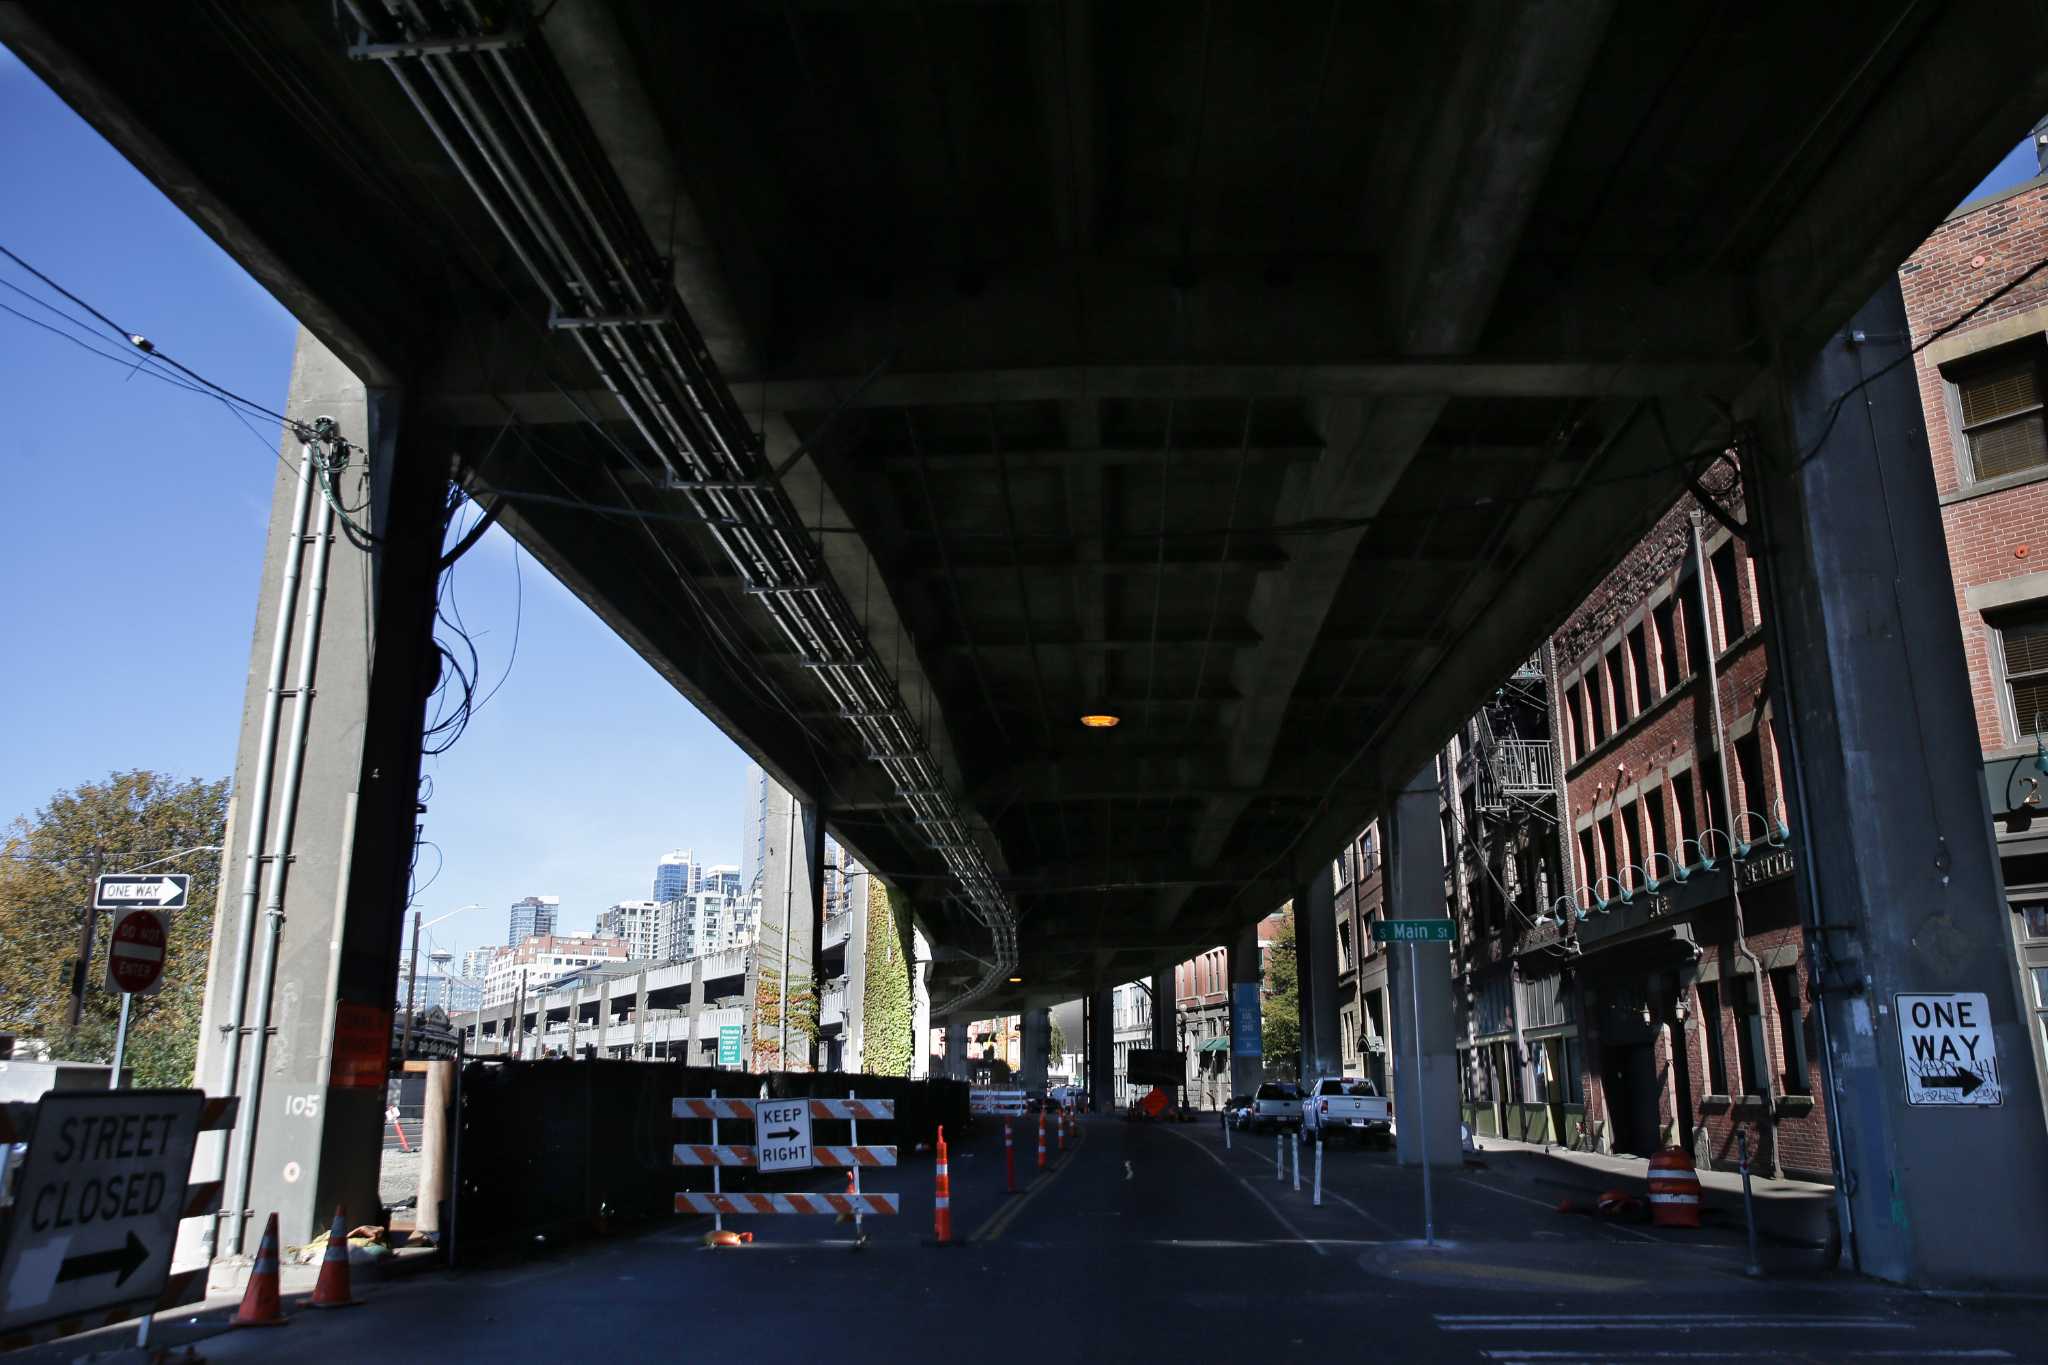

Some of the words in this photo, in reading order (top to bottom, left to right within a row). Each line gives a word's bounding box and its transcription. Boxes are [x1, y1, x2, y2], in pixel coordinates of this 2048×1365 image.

[108, 885, 131, 897] ONE
[136, 884, 161, 897] WAY
[119, 923, 136, 938] DO
[1380, 927, 1386, 939] S
[1394, 923, 1428, 939] Main
[1438, 927, 1447, 938] St
[120, 960, 152, 977] ENTER
[1912, 1002, 1976, 1028] ONE
[1912, 1035, 1979, 1061] WAY
[285, 1094, 320, 1118] 105
[764, 1108, 802, 1124] KEEP
[55, 1114, 178, 1164] STREET
[763, 1146, 807, 1162] RIGHT
[31, 1171, 167, 1233] CLOSED
